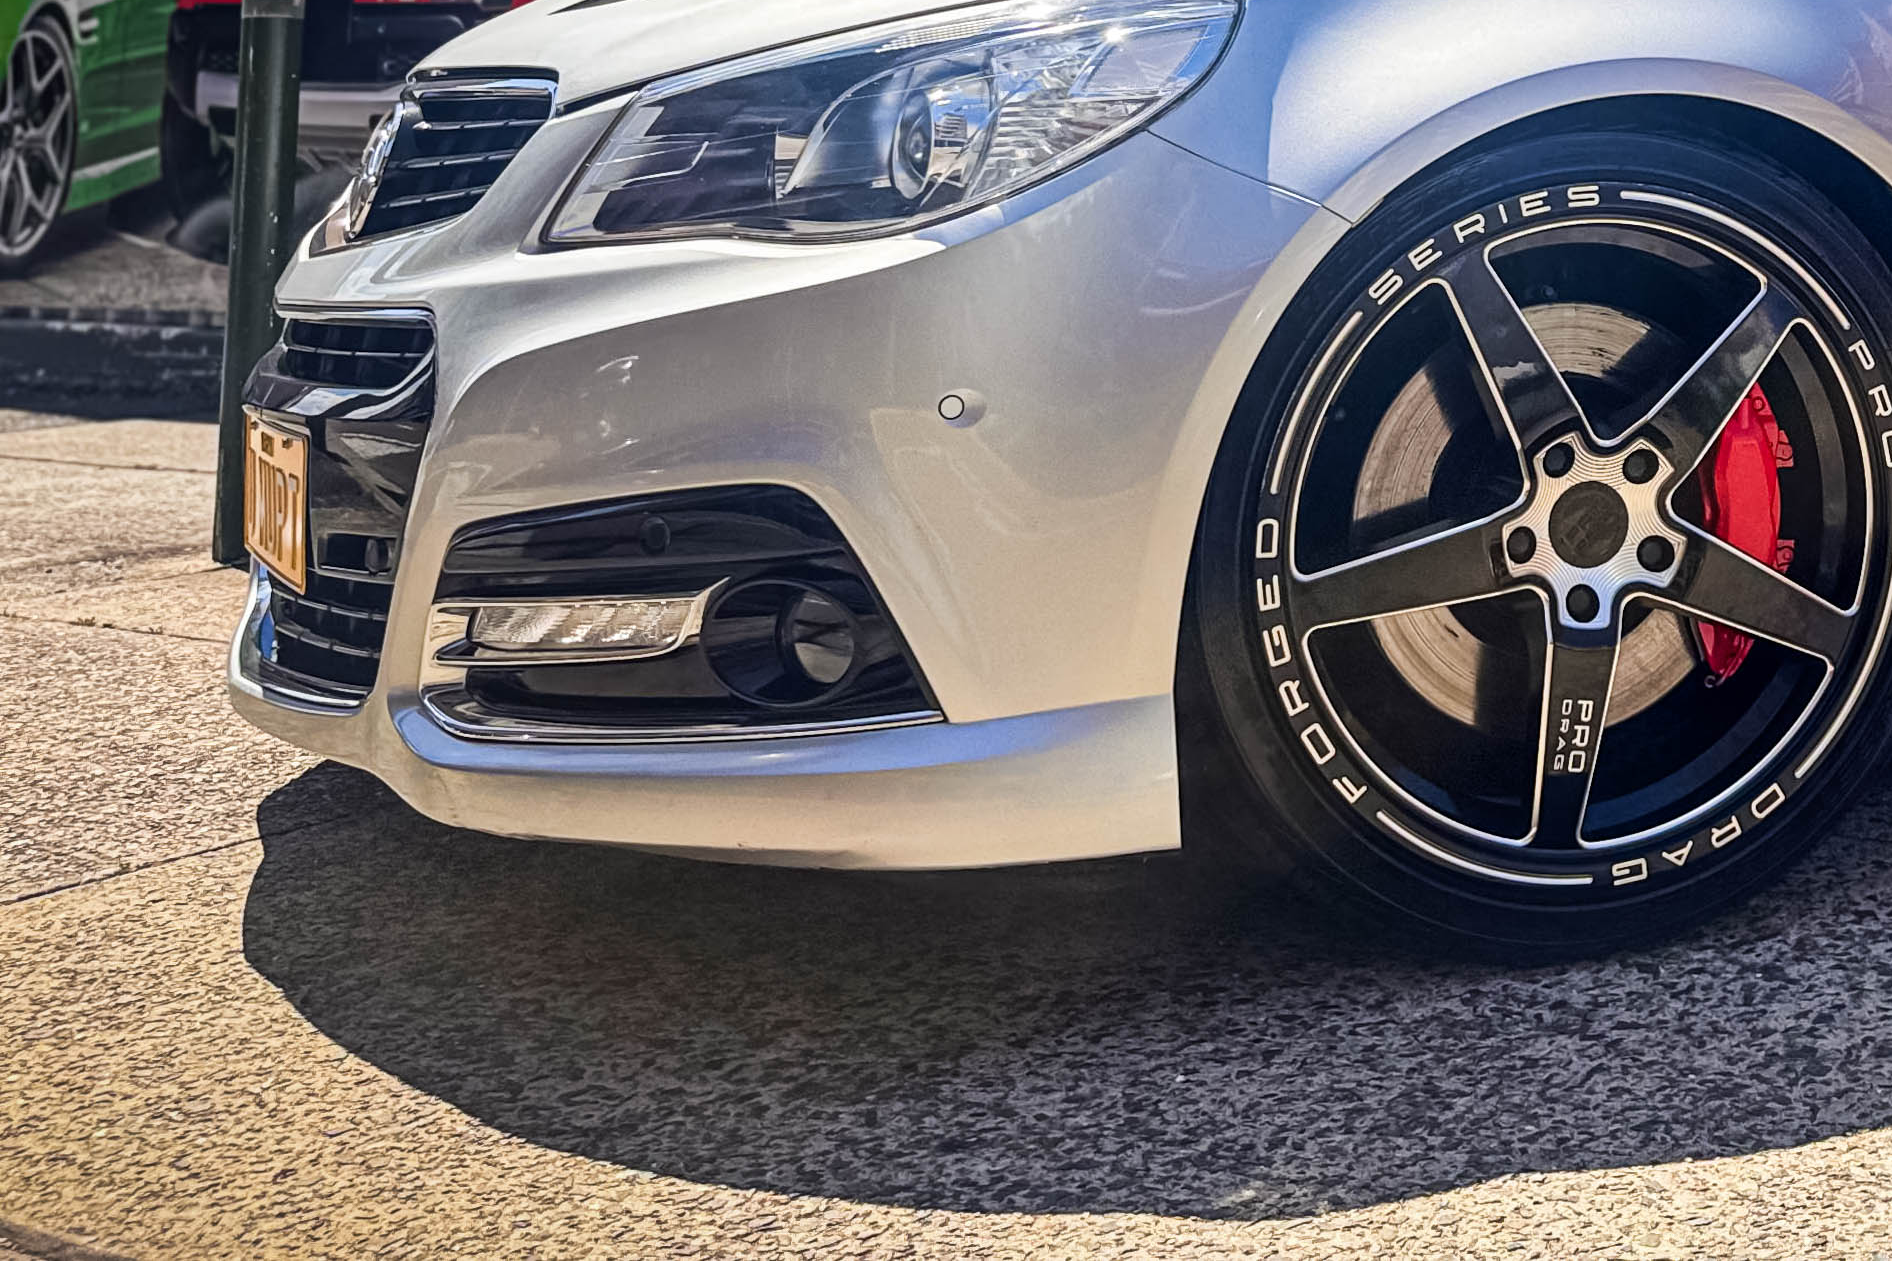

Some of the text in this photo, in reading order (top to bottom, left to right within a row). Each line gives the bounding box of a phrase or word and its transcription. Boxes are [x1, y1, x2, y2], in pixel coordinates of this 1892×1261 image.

[1369, 185, 1600, 304] SERIES
[1255, 517, 1368, 805] FORGED
[1553, 699, 1573, 771] DRAG
[1567, 699, 1594, 773] PRO
[1612, 783, 1785, 886] DRAG
